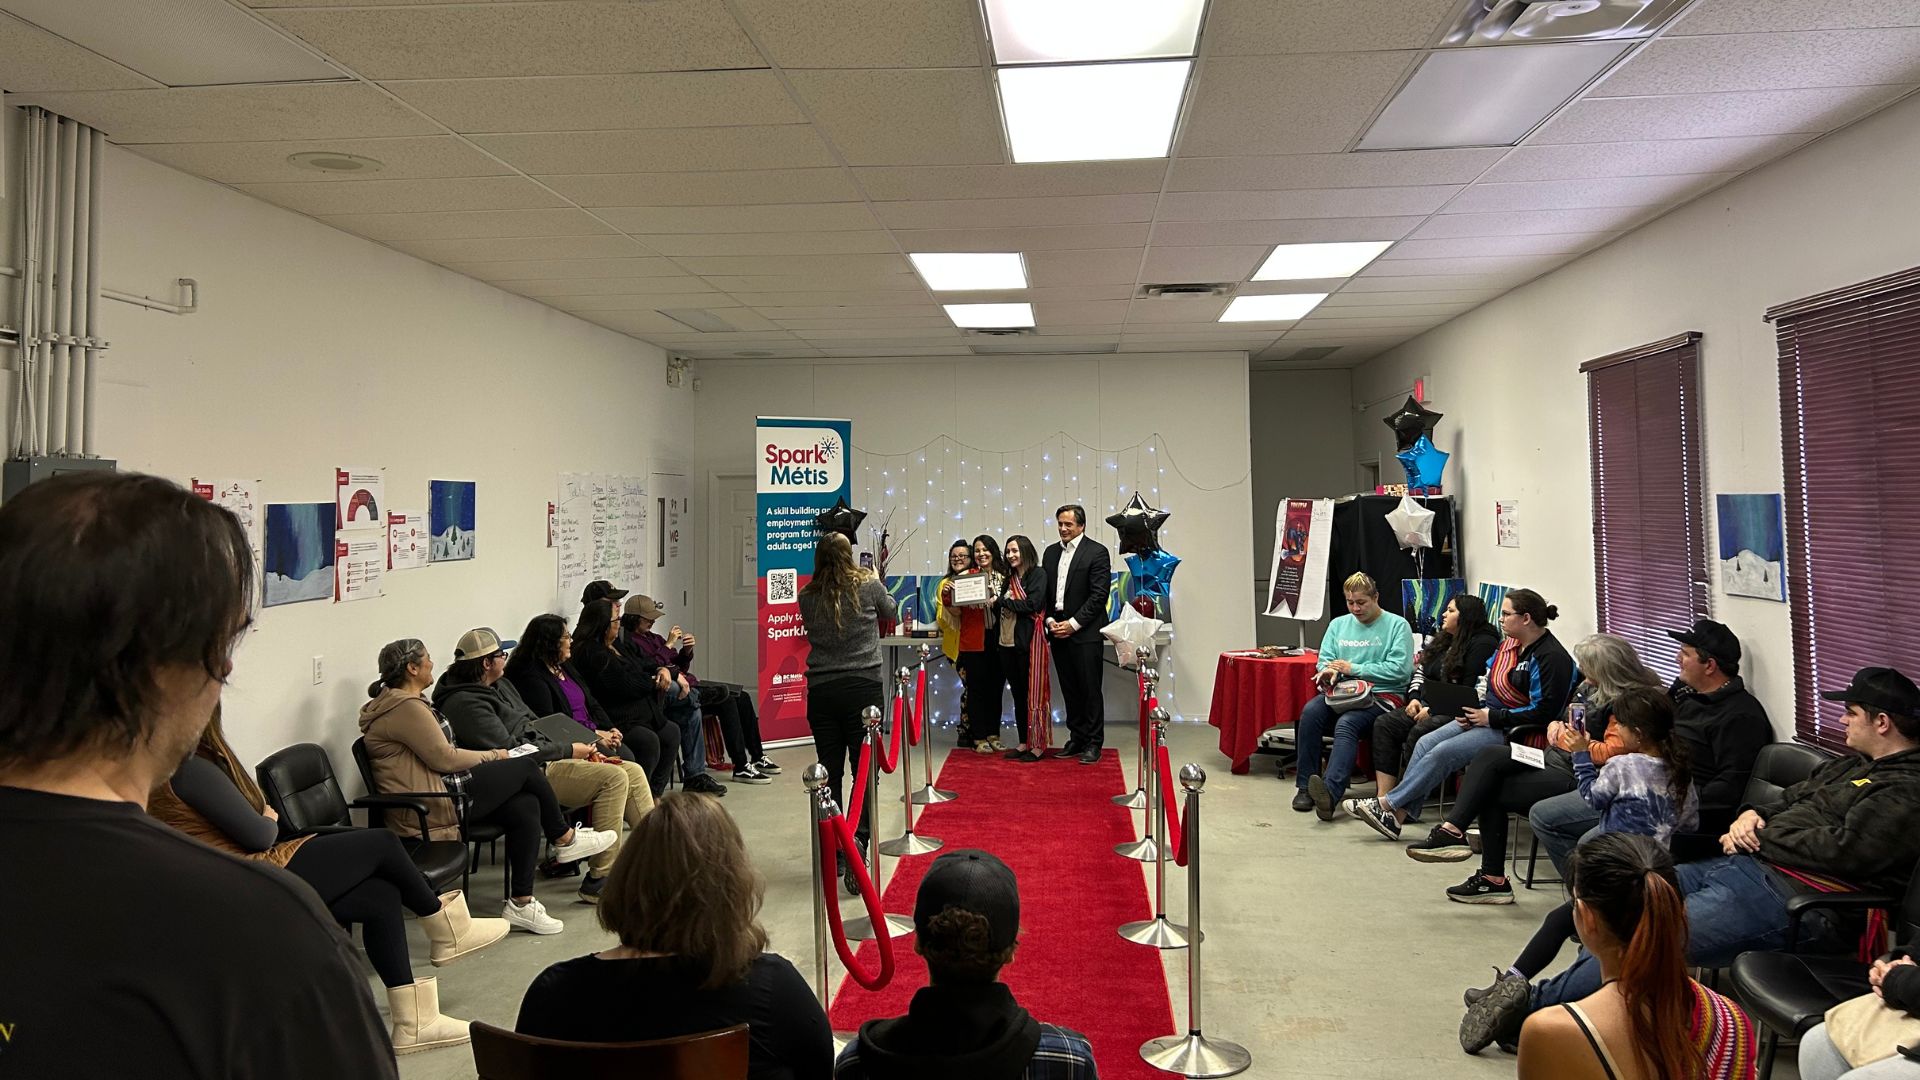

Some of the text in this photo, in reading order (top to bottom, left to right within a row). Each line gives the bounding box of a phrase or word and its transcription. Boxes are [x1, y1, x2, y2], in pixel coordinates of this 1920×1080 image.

[765, 444, 827, 470] Spark
[771, 466, 828, 485] Métis
[766, 507, 772, 515] A
[774, 507, 789, 515] skill
[790, 506, 820, 516] building
[767, 519, 813, 528] employment
[767, 532, 799, 541] program
[767, 542, 791, 550] adults
[793, 541, 812, 551] aged
[768, 613, 793, 624] Apply
[1338, 639, 1370, 647] Reebok
